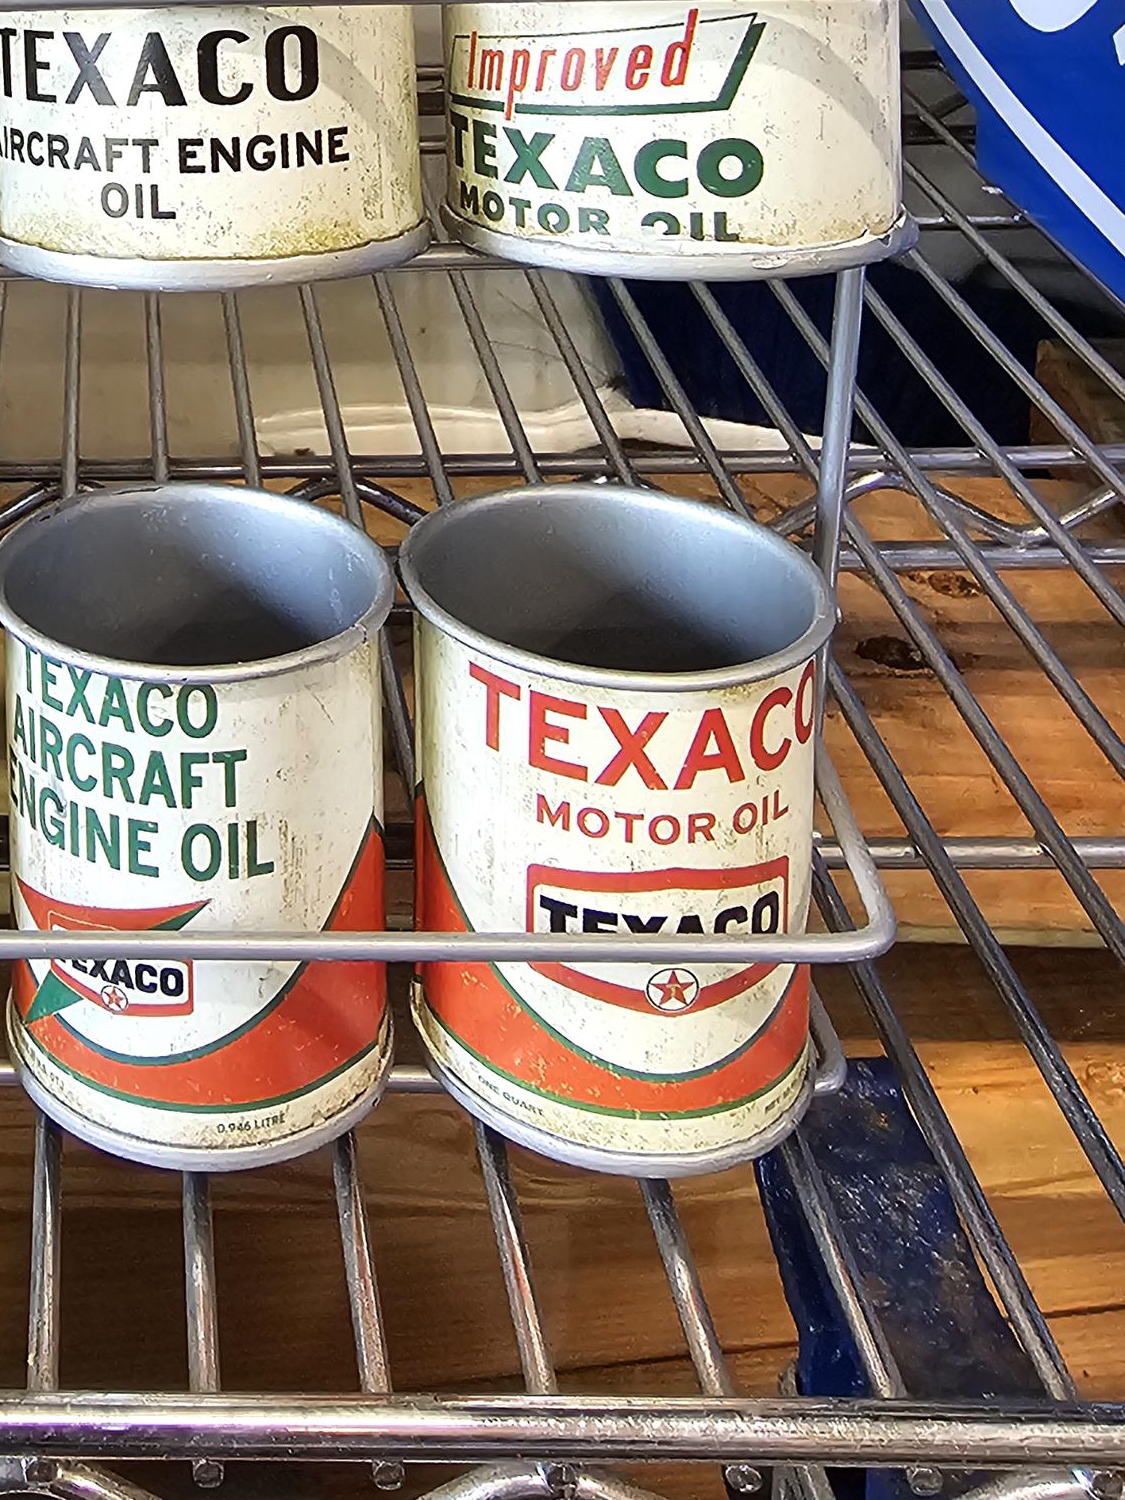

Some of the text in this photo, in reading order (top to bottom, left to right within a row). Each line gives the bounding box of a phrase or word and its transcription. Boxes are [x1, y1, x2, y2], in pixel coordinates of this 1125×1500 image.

[467, 8, 700, 121] Improved
[178, 127, 350, 175] ENGINE
[451, 110, 765, 199] TEXACO
[101, 183, 177, 220] OIL
[460, 180, 611, 236] MOTOR
[25, 644, 218, 739] TEXACO
[469, 657, 816, 791] TEXACO
[14, 693, 247, 809] AIRCRAFT
[9, 743, 274, 882] ENGINE OIL
[536, 788, 789, 845] MOTOR OIL
[59, 959, 184, 997] EXACO
